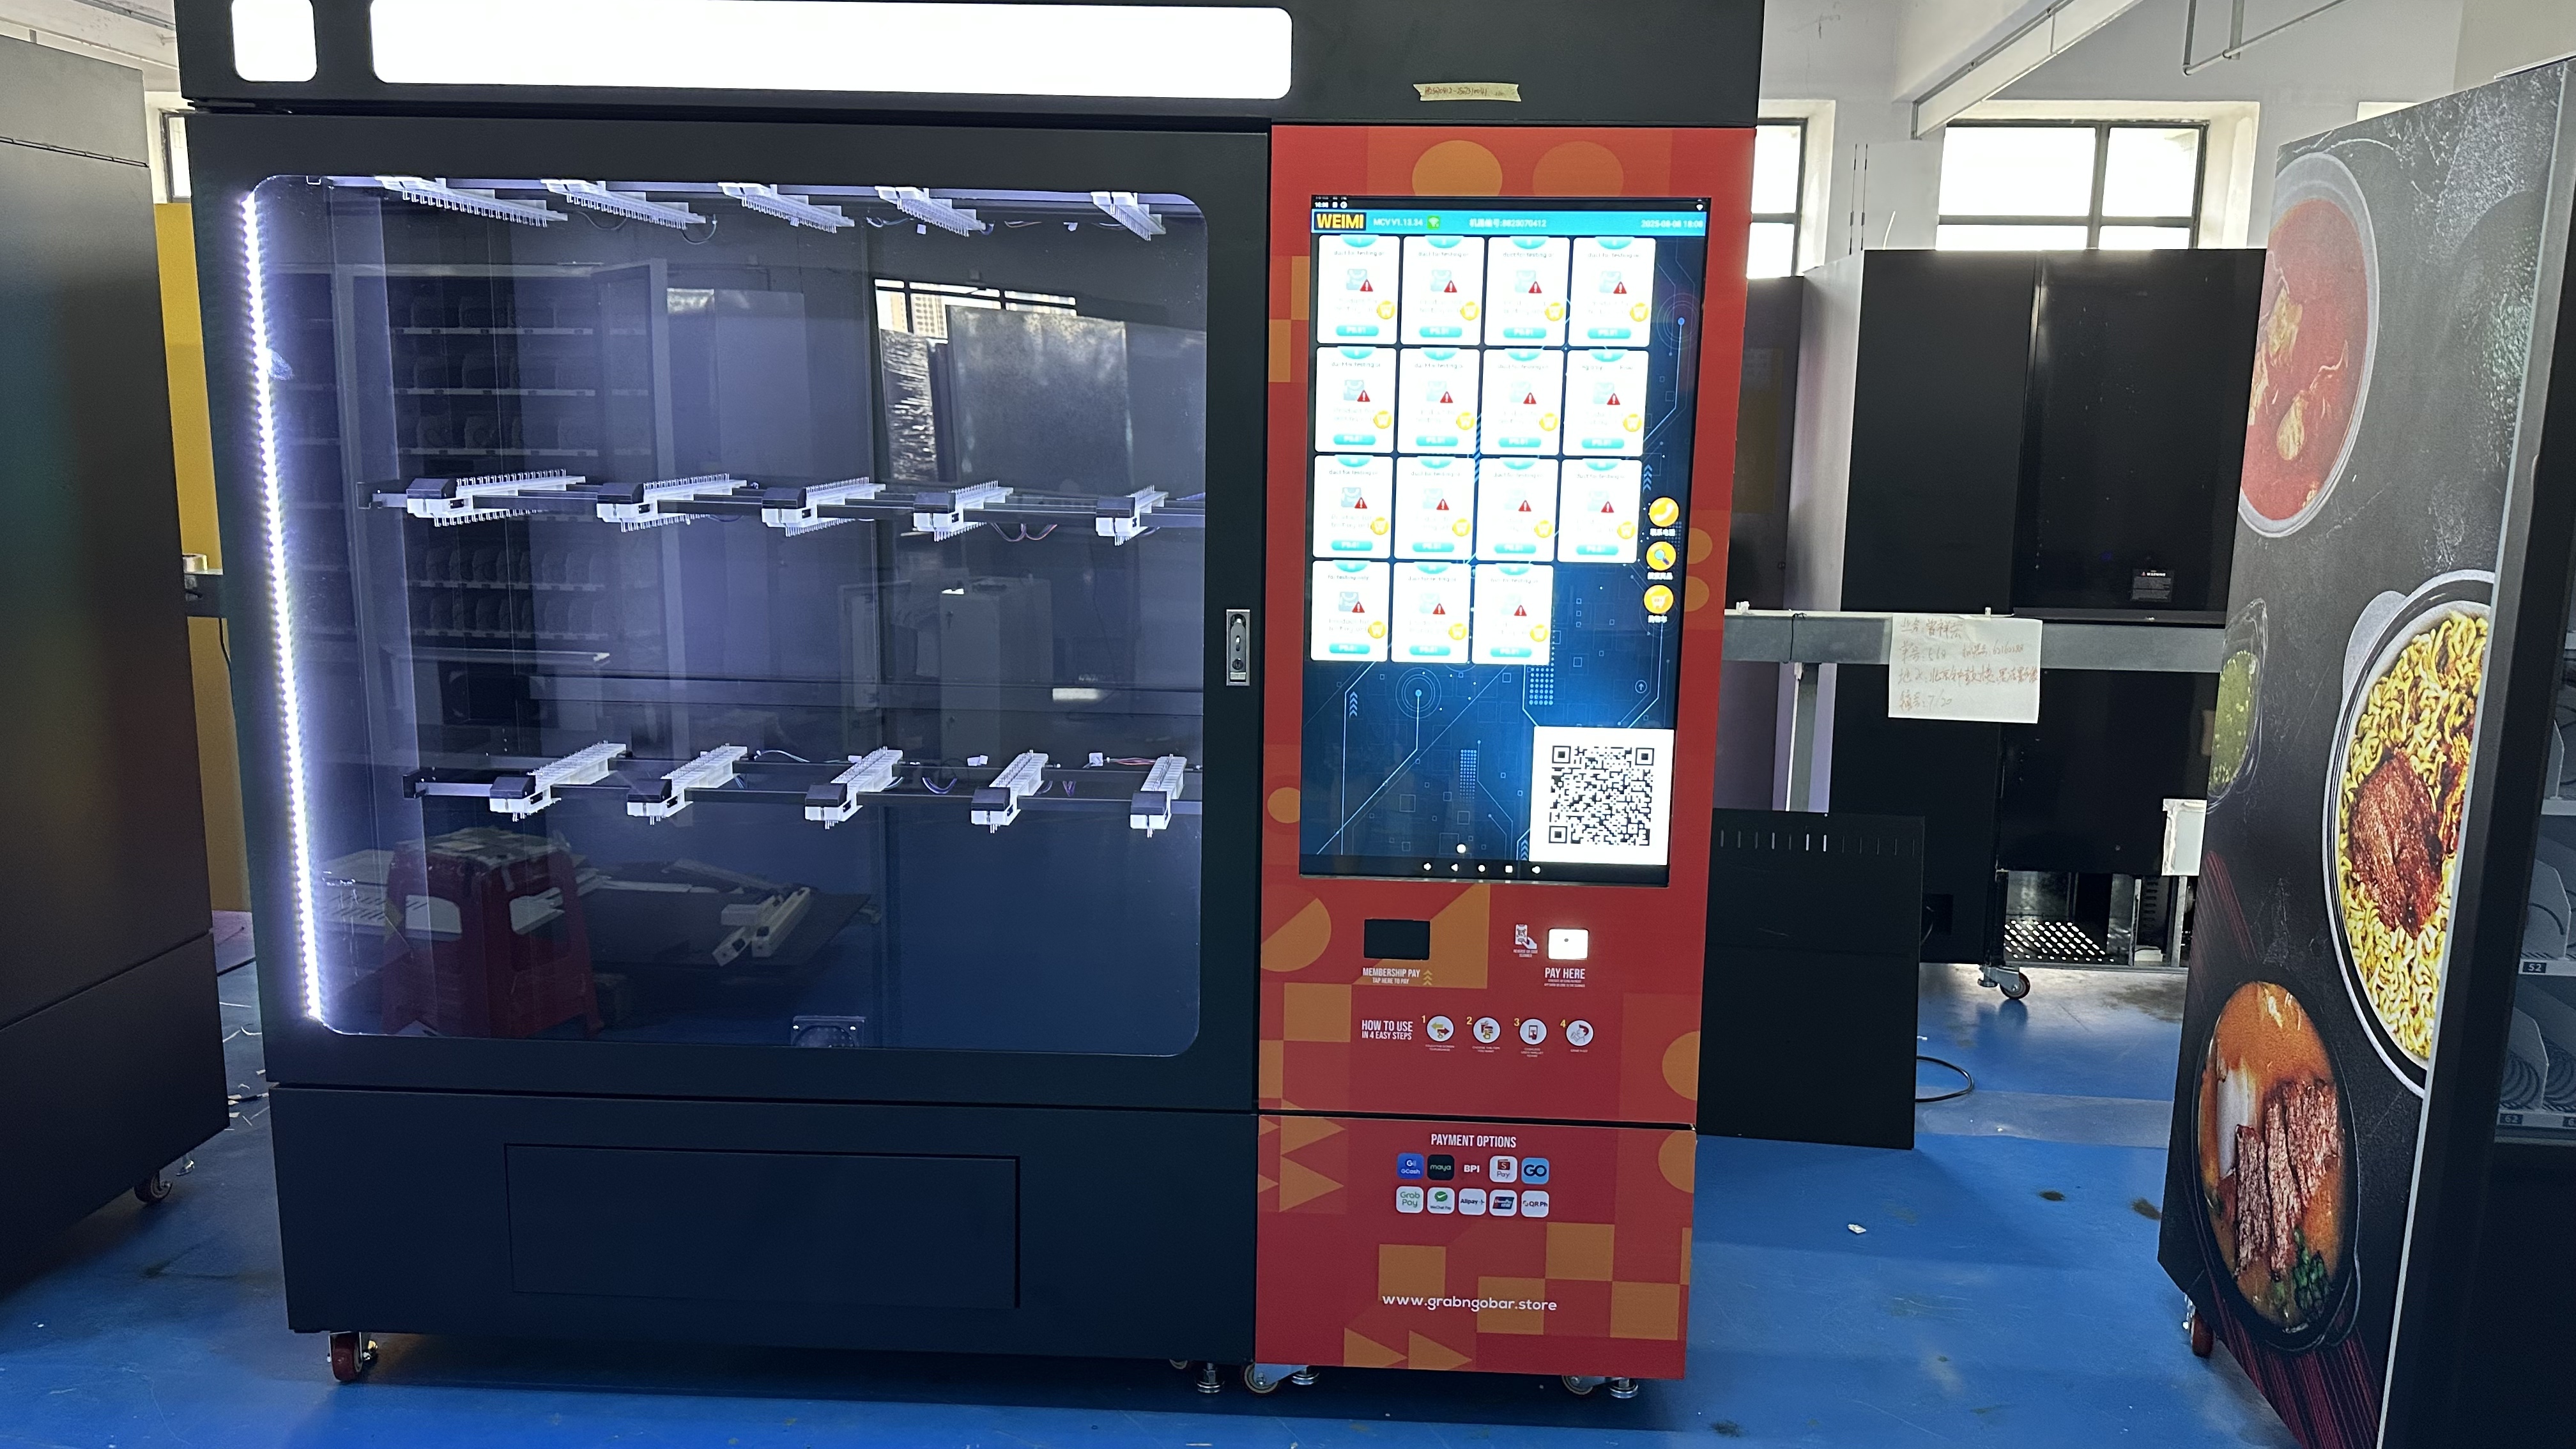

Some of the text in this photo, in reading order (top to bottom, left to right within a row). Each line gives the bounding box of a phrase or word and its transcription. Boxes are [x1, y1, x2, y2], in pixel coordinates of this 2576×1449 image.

[1316, 213, 1364, 229] WEIMI
[1362, 967, 1420, 977] MEMBERSHIP PAY
[2528, 963, 2542, 972] 52
[1545, 967, 1586, 979] PAY HERE
[1422, 1015, 1426, 1023] 1
[1466, 1016, 1473, 1025] 2
[1514, 1018, 1520, 1027] 3
[1560, 1019, 1566, 1028] 4
[1361, 1020, 1413, 1032] HOW TO USE
[1361, 1031, 1368, 1039] IN
[1376, 1031, 1391, 1039] EASY
[1392, 1032, 1412, 1040] STEPS
[2504, 1114, 2518, 1123] 62
[1430, 1133, 1517, 1148] PAYMENT OPTIONS
[1464, 1165, 1480, 1173] BPI
[1523, 1164, 1547, 1177] GO
[1496, 1170, 1510, 1179] Pay
[1400, 1191, 1420, 1199] Grab
[1402, 1199, 1418, 1208] Pay
[1382, 1296, 1558, 1312] www.grabngobar.store
